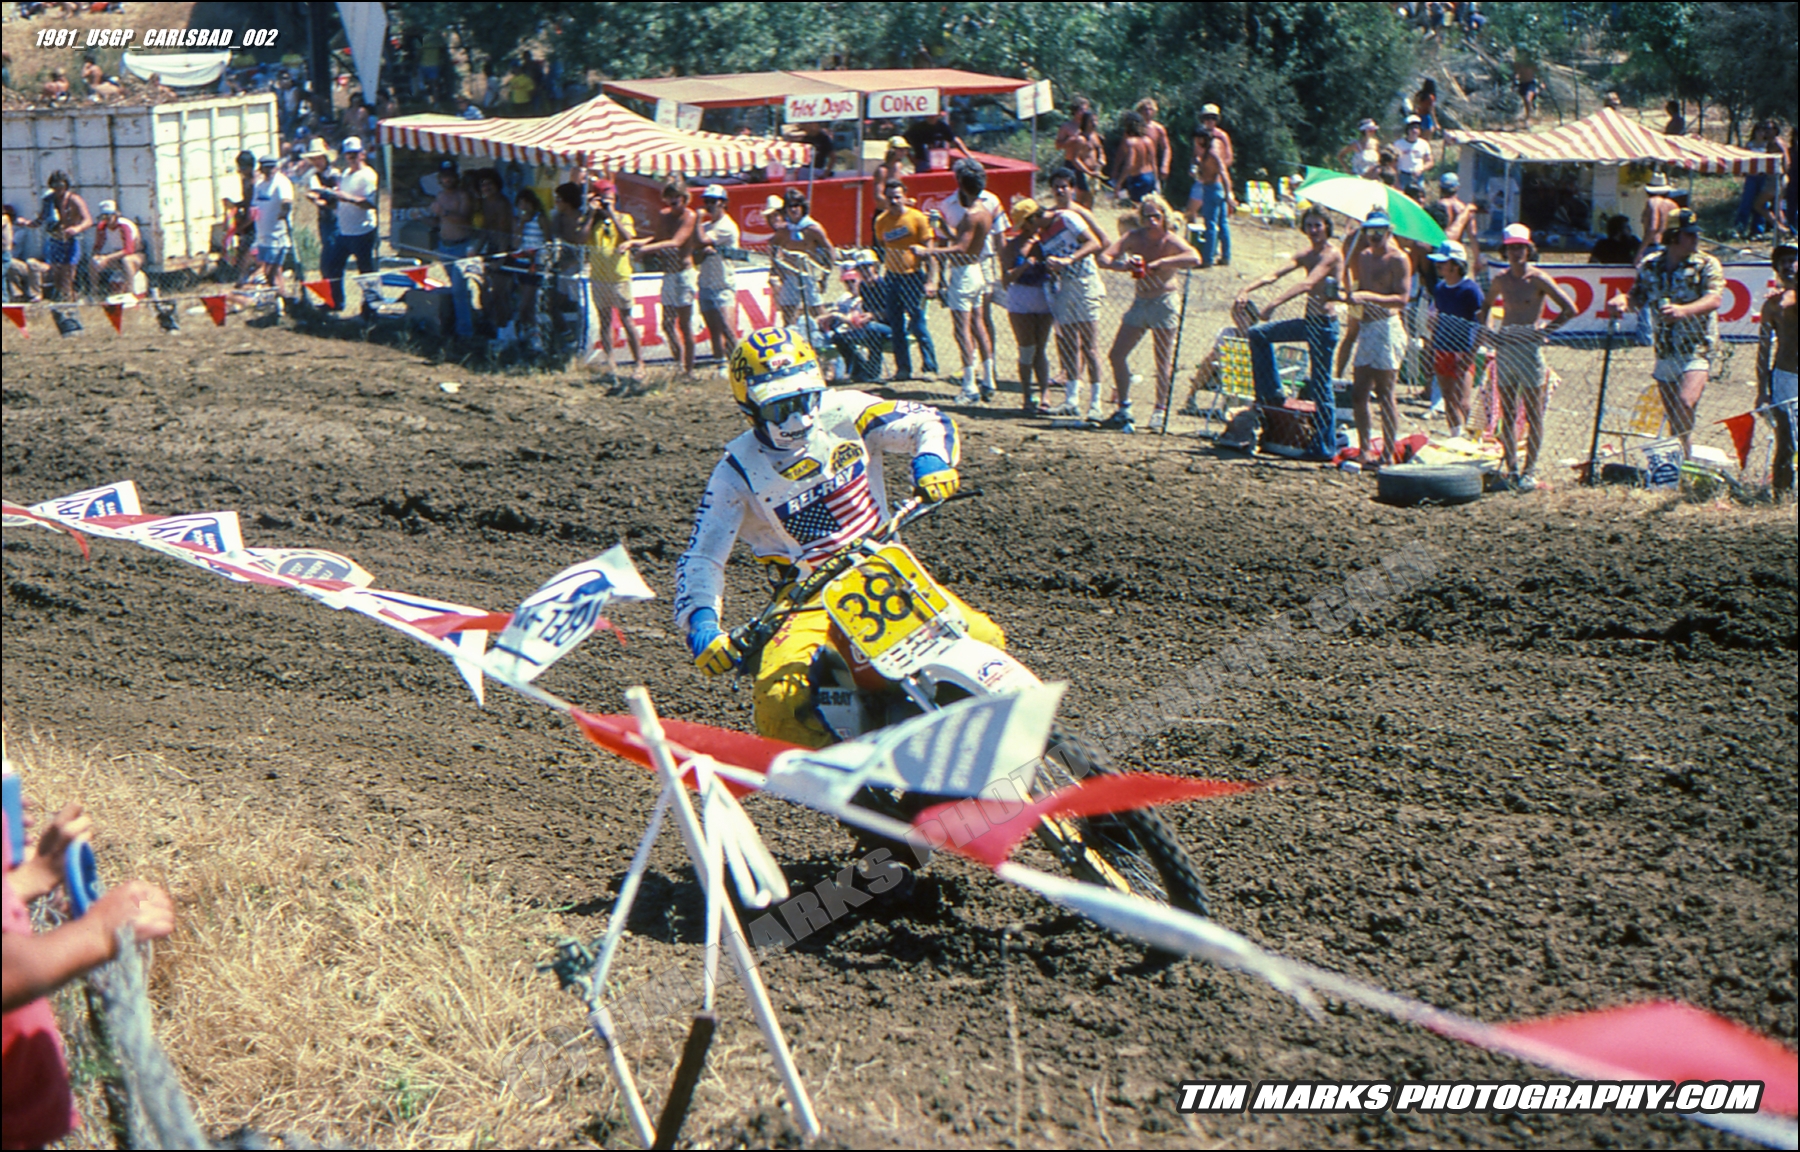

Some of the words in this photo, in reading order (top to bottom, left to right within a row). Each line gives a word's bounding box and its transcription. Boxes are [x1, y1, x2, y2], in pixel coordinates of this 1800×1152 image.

[786, 465, 856, 515] BEL-RAY
[837, 571, 914, 643] 38
[818, 690, 852, 706] EL-RAY
